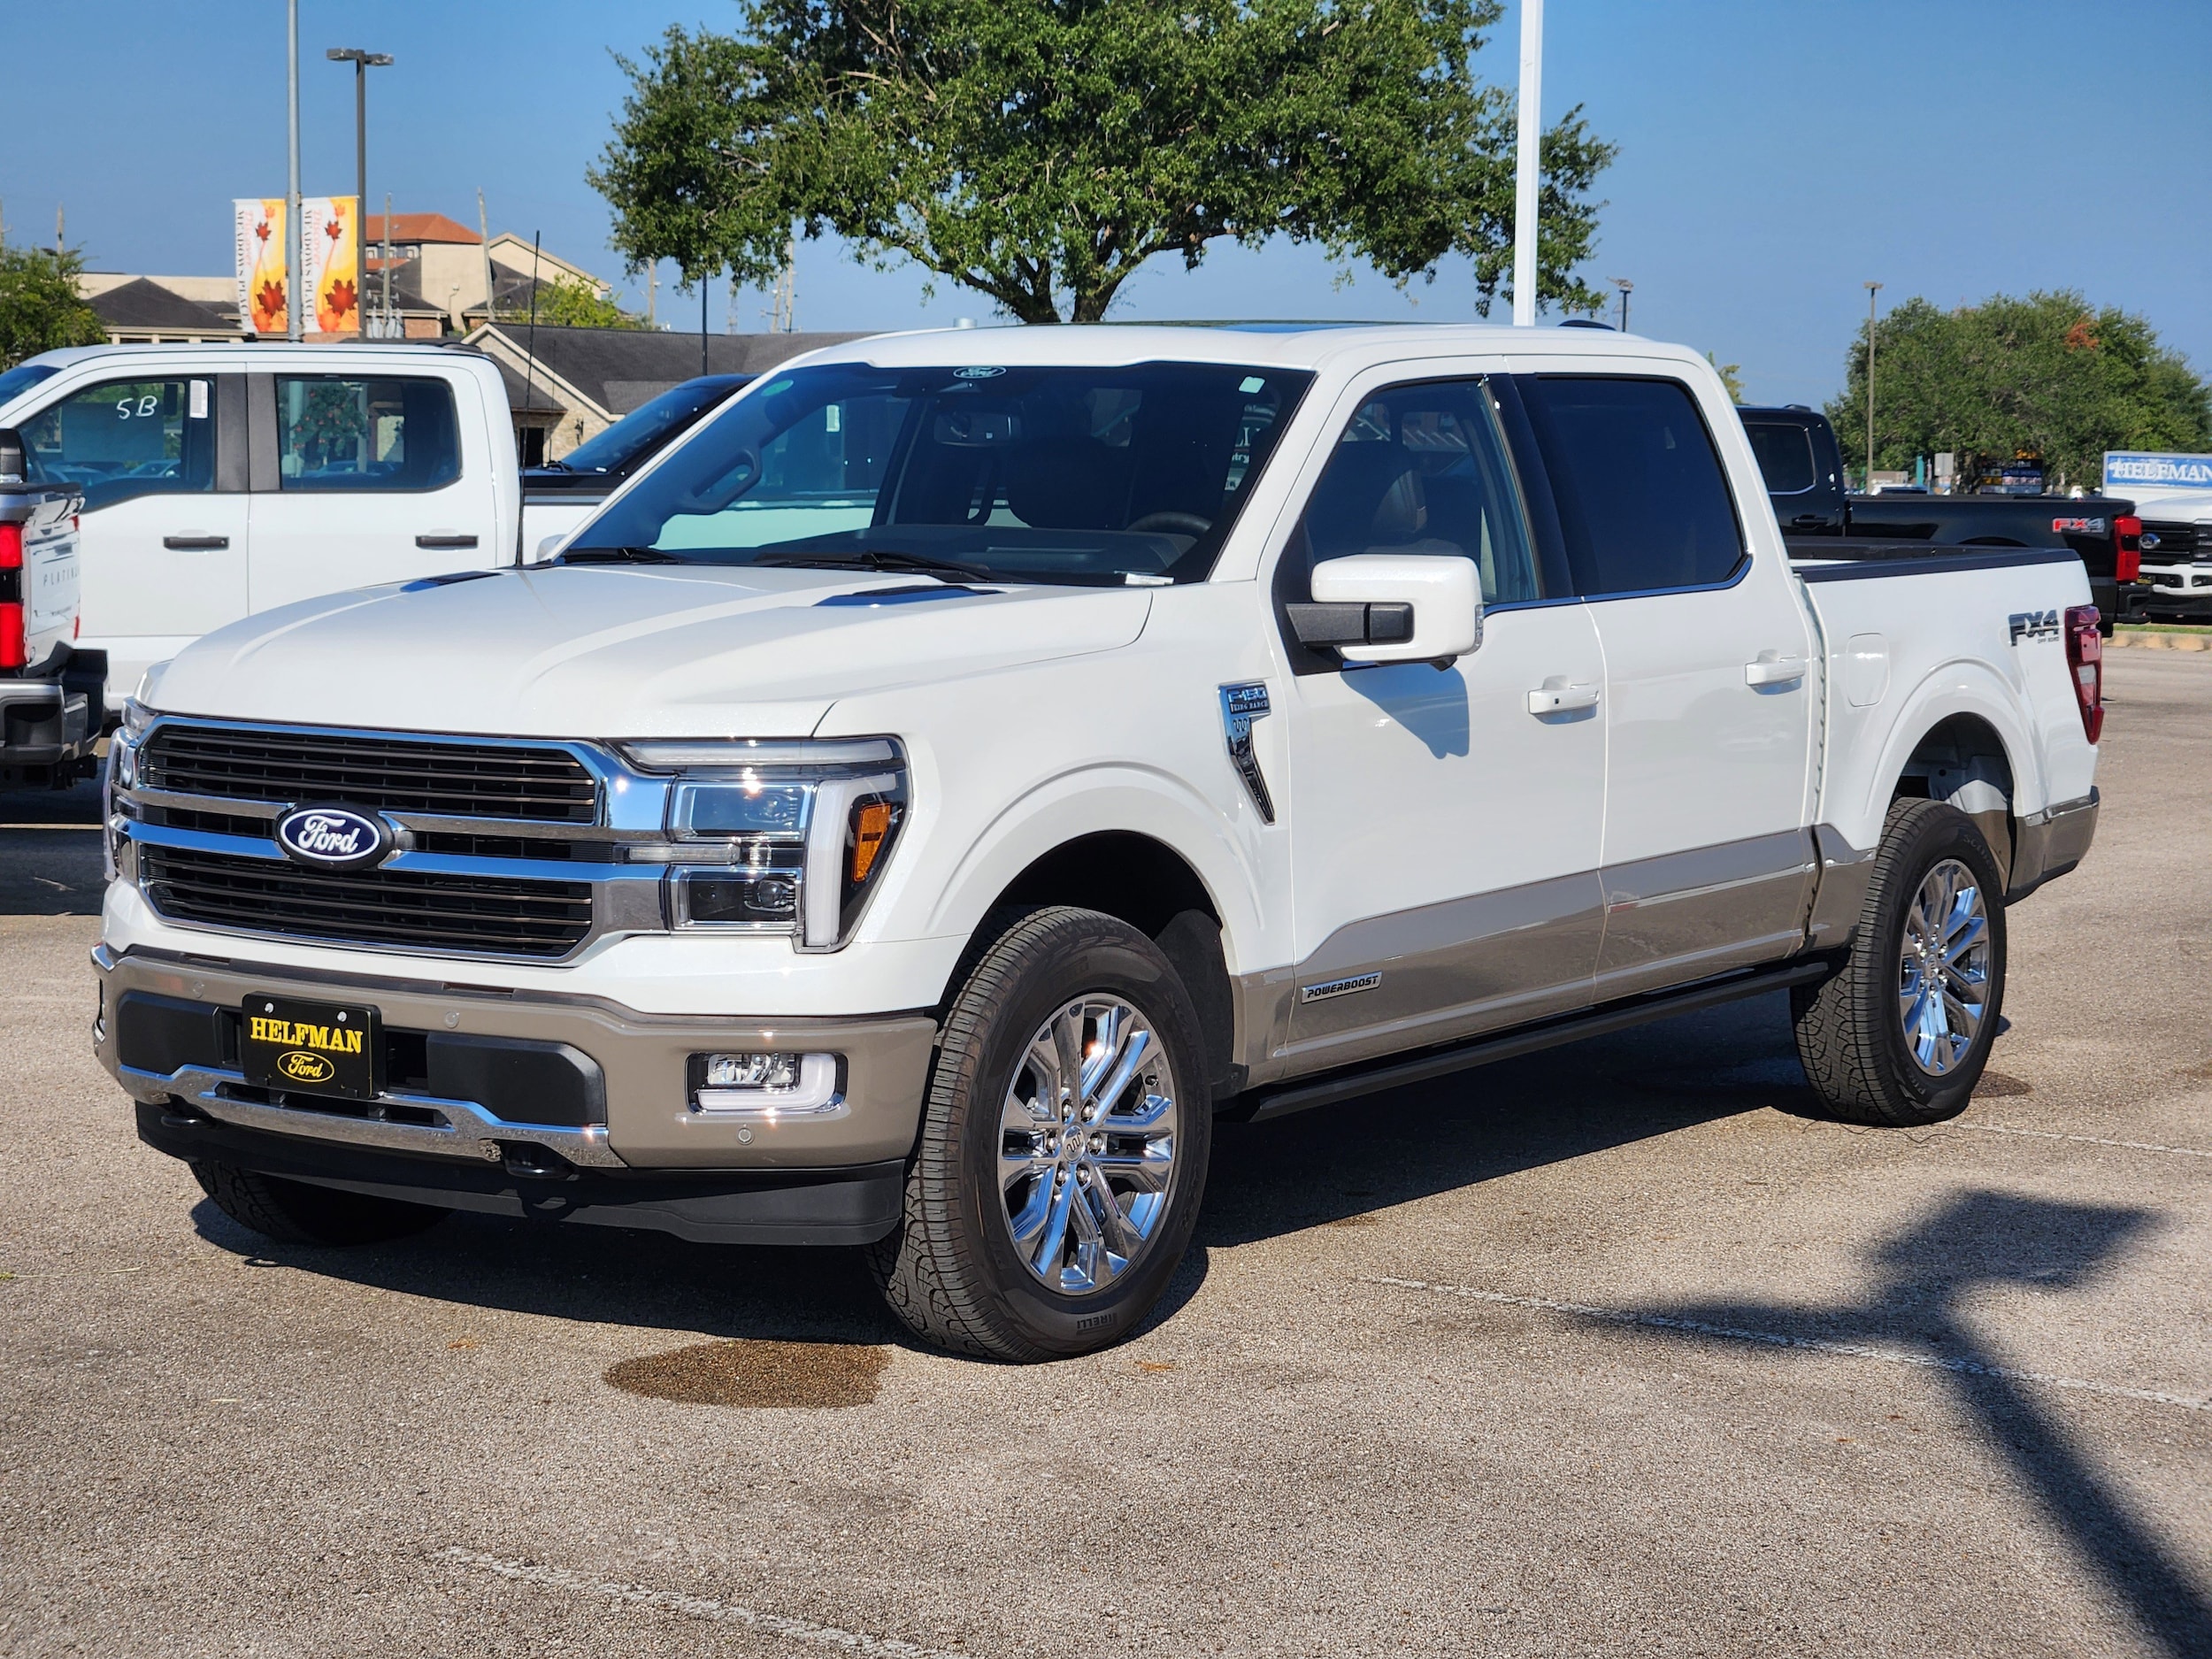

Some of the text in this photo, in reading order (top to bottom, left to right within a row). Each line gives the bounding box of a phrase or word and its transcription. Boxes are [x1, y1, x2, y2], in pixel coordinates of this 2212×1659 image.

[303, 210, 314, 322] MEADOWS PLACE
[238, 280, 250, 322] PLACE
[2053, 518, 2105, 533] FX4
[2008, 610, 2059, 646] FX4
[298, 812, 361, 854] Ford
[1307, 975, 1379, 998] POWERBOOST
[250, 1017, 364, 1054] HELFMAN
[288, 1054, 324, 1079] Ford
